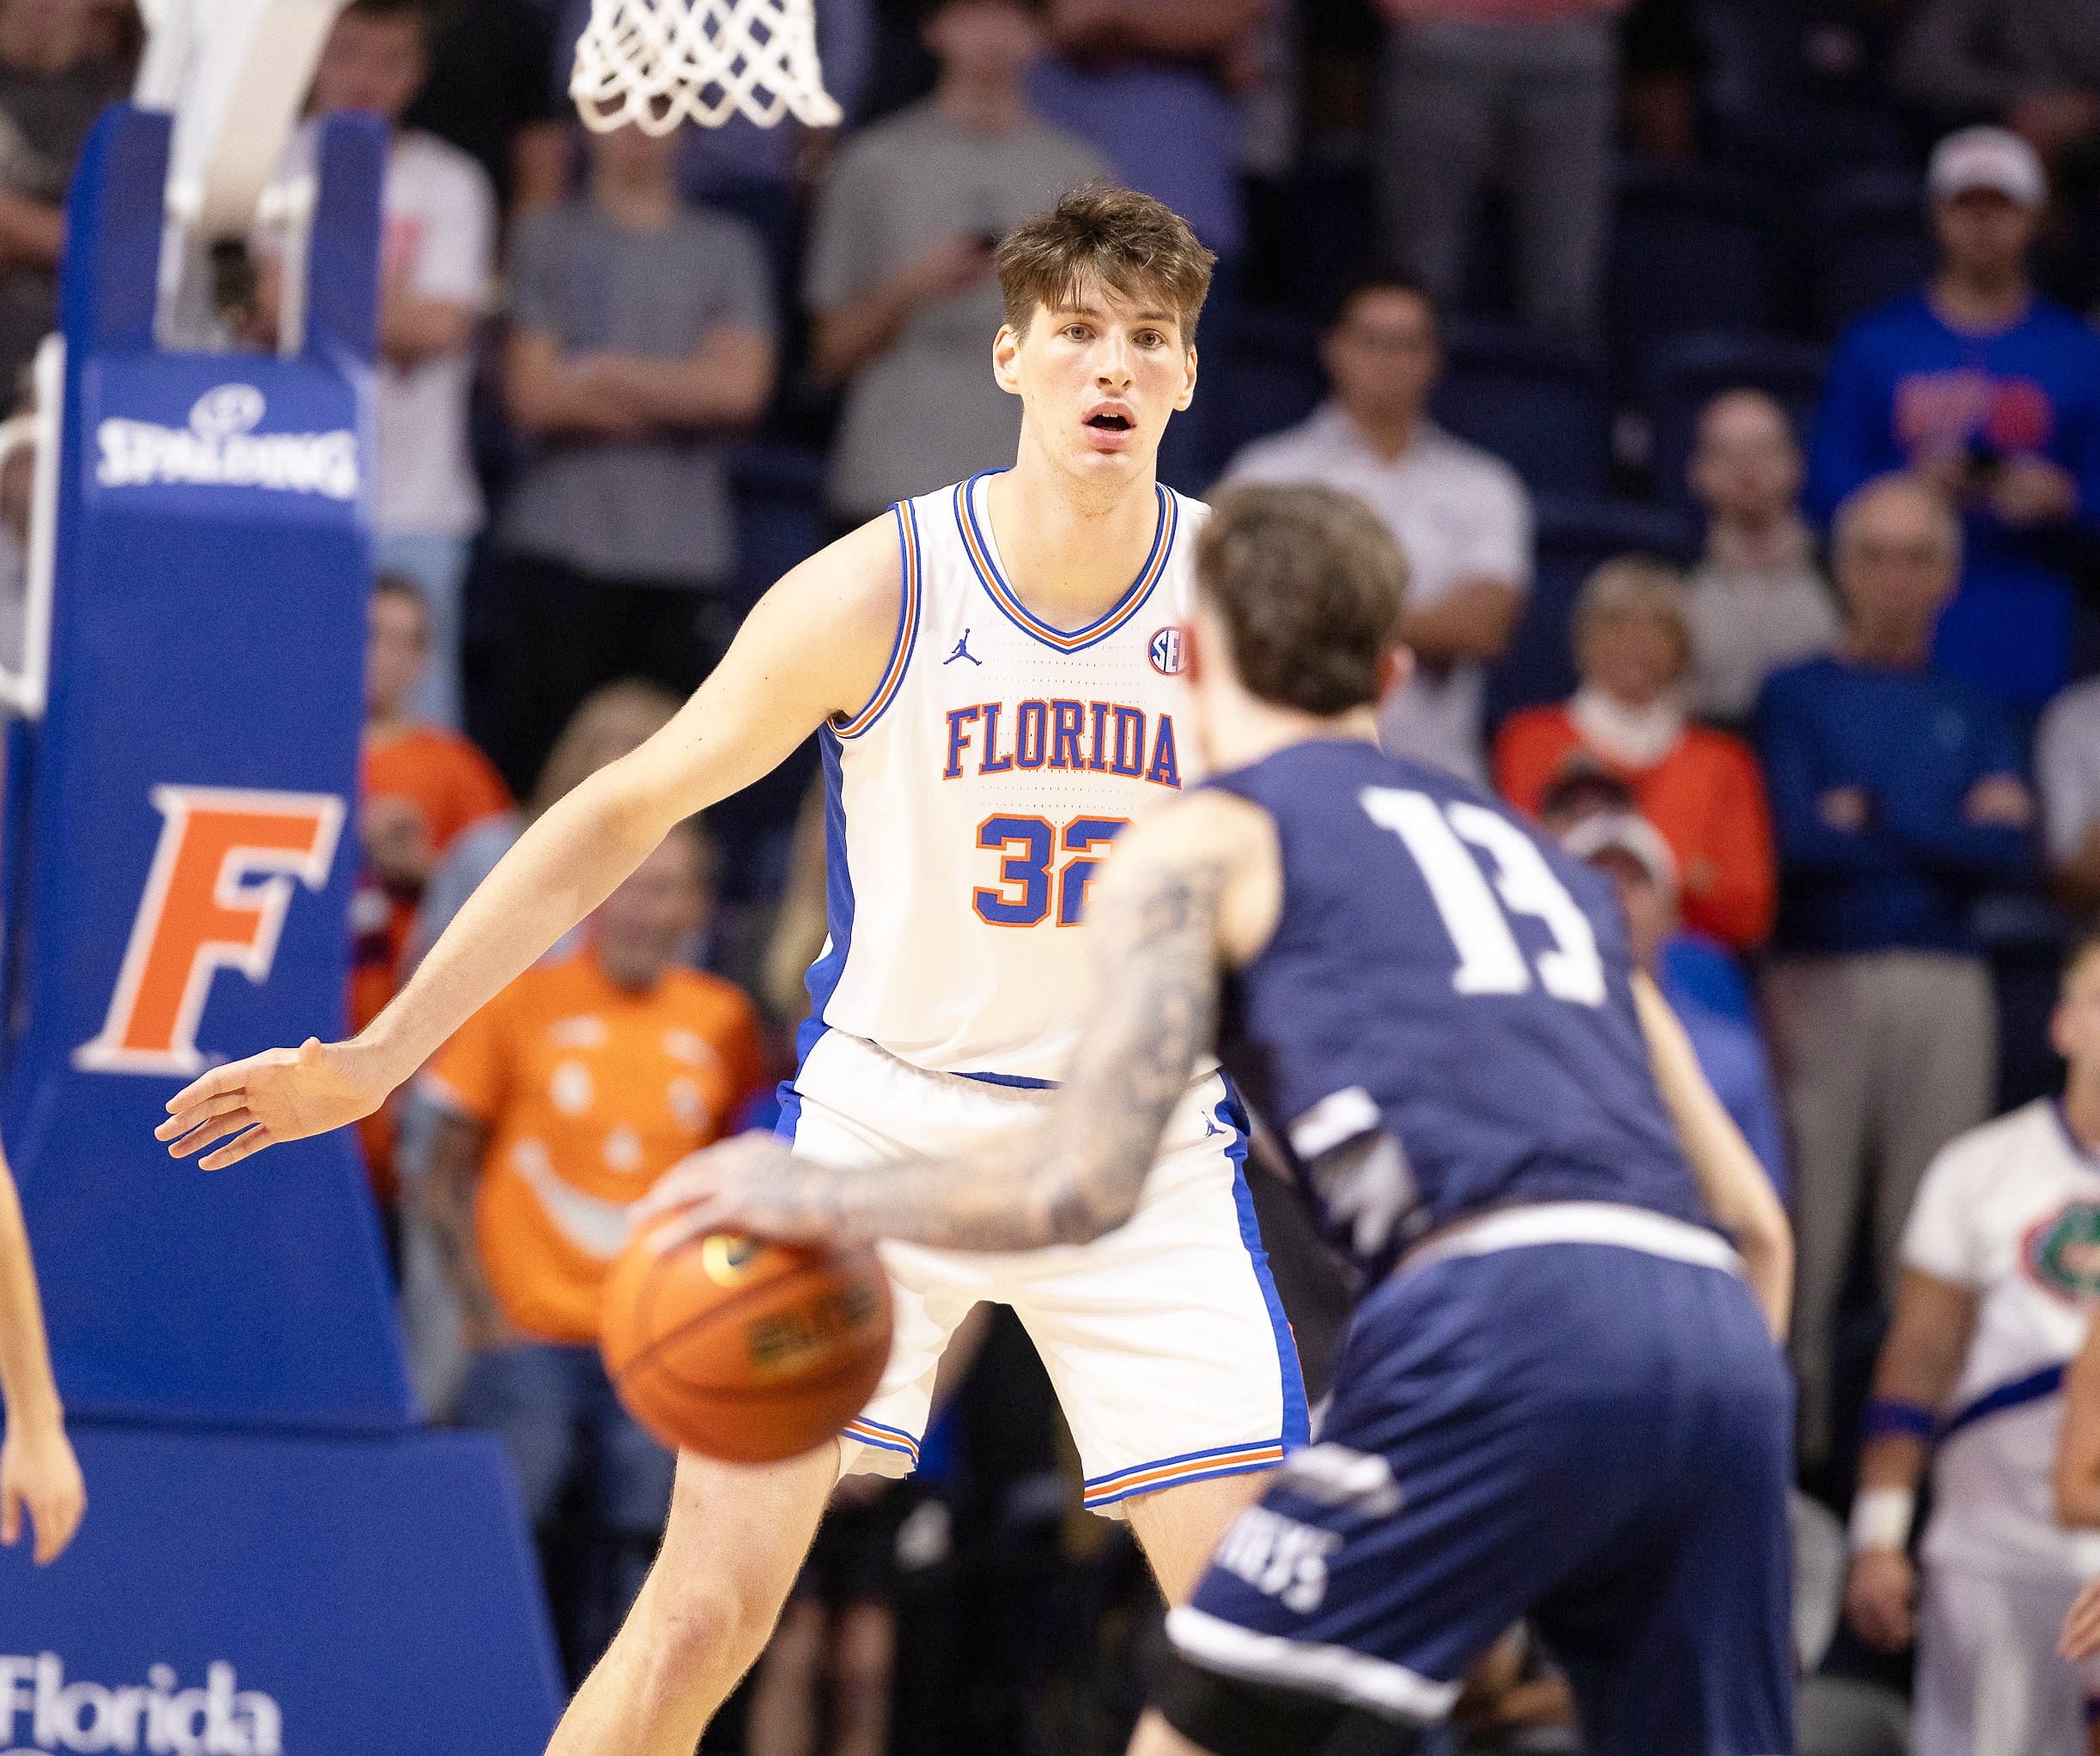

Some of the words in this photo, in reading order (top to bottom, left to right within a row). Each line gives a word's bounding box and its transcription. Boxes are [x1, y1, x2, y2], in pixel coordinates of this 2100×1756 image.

[96, 416, 356, 498] SPALDING
[943, 699, 1182, 790] FLORIDA
[70, 783, 345, 1075] F
[1360, 786, 1604, 1007] 13
[0, 1651, 281, 1756] Florida
